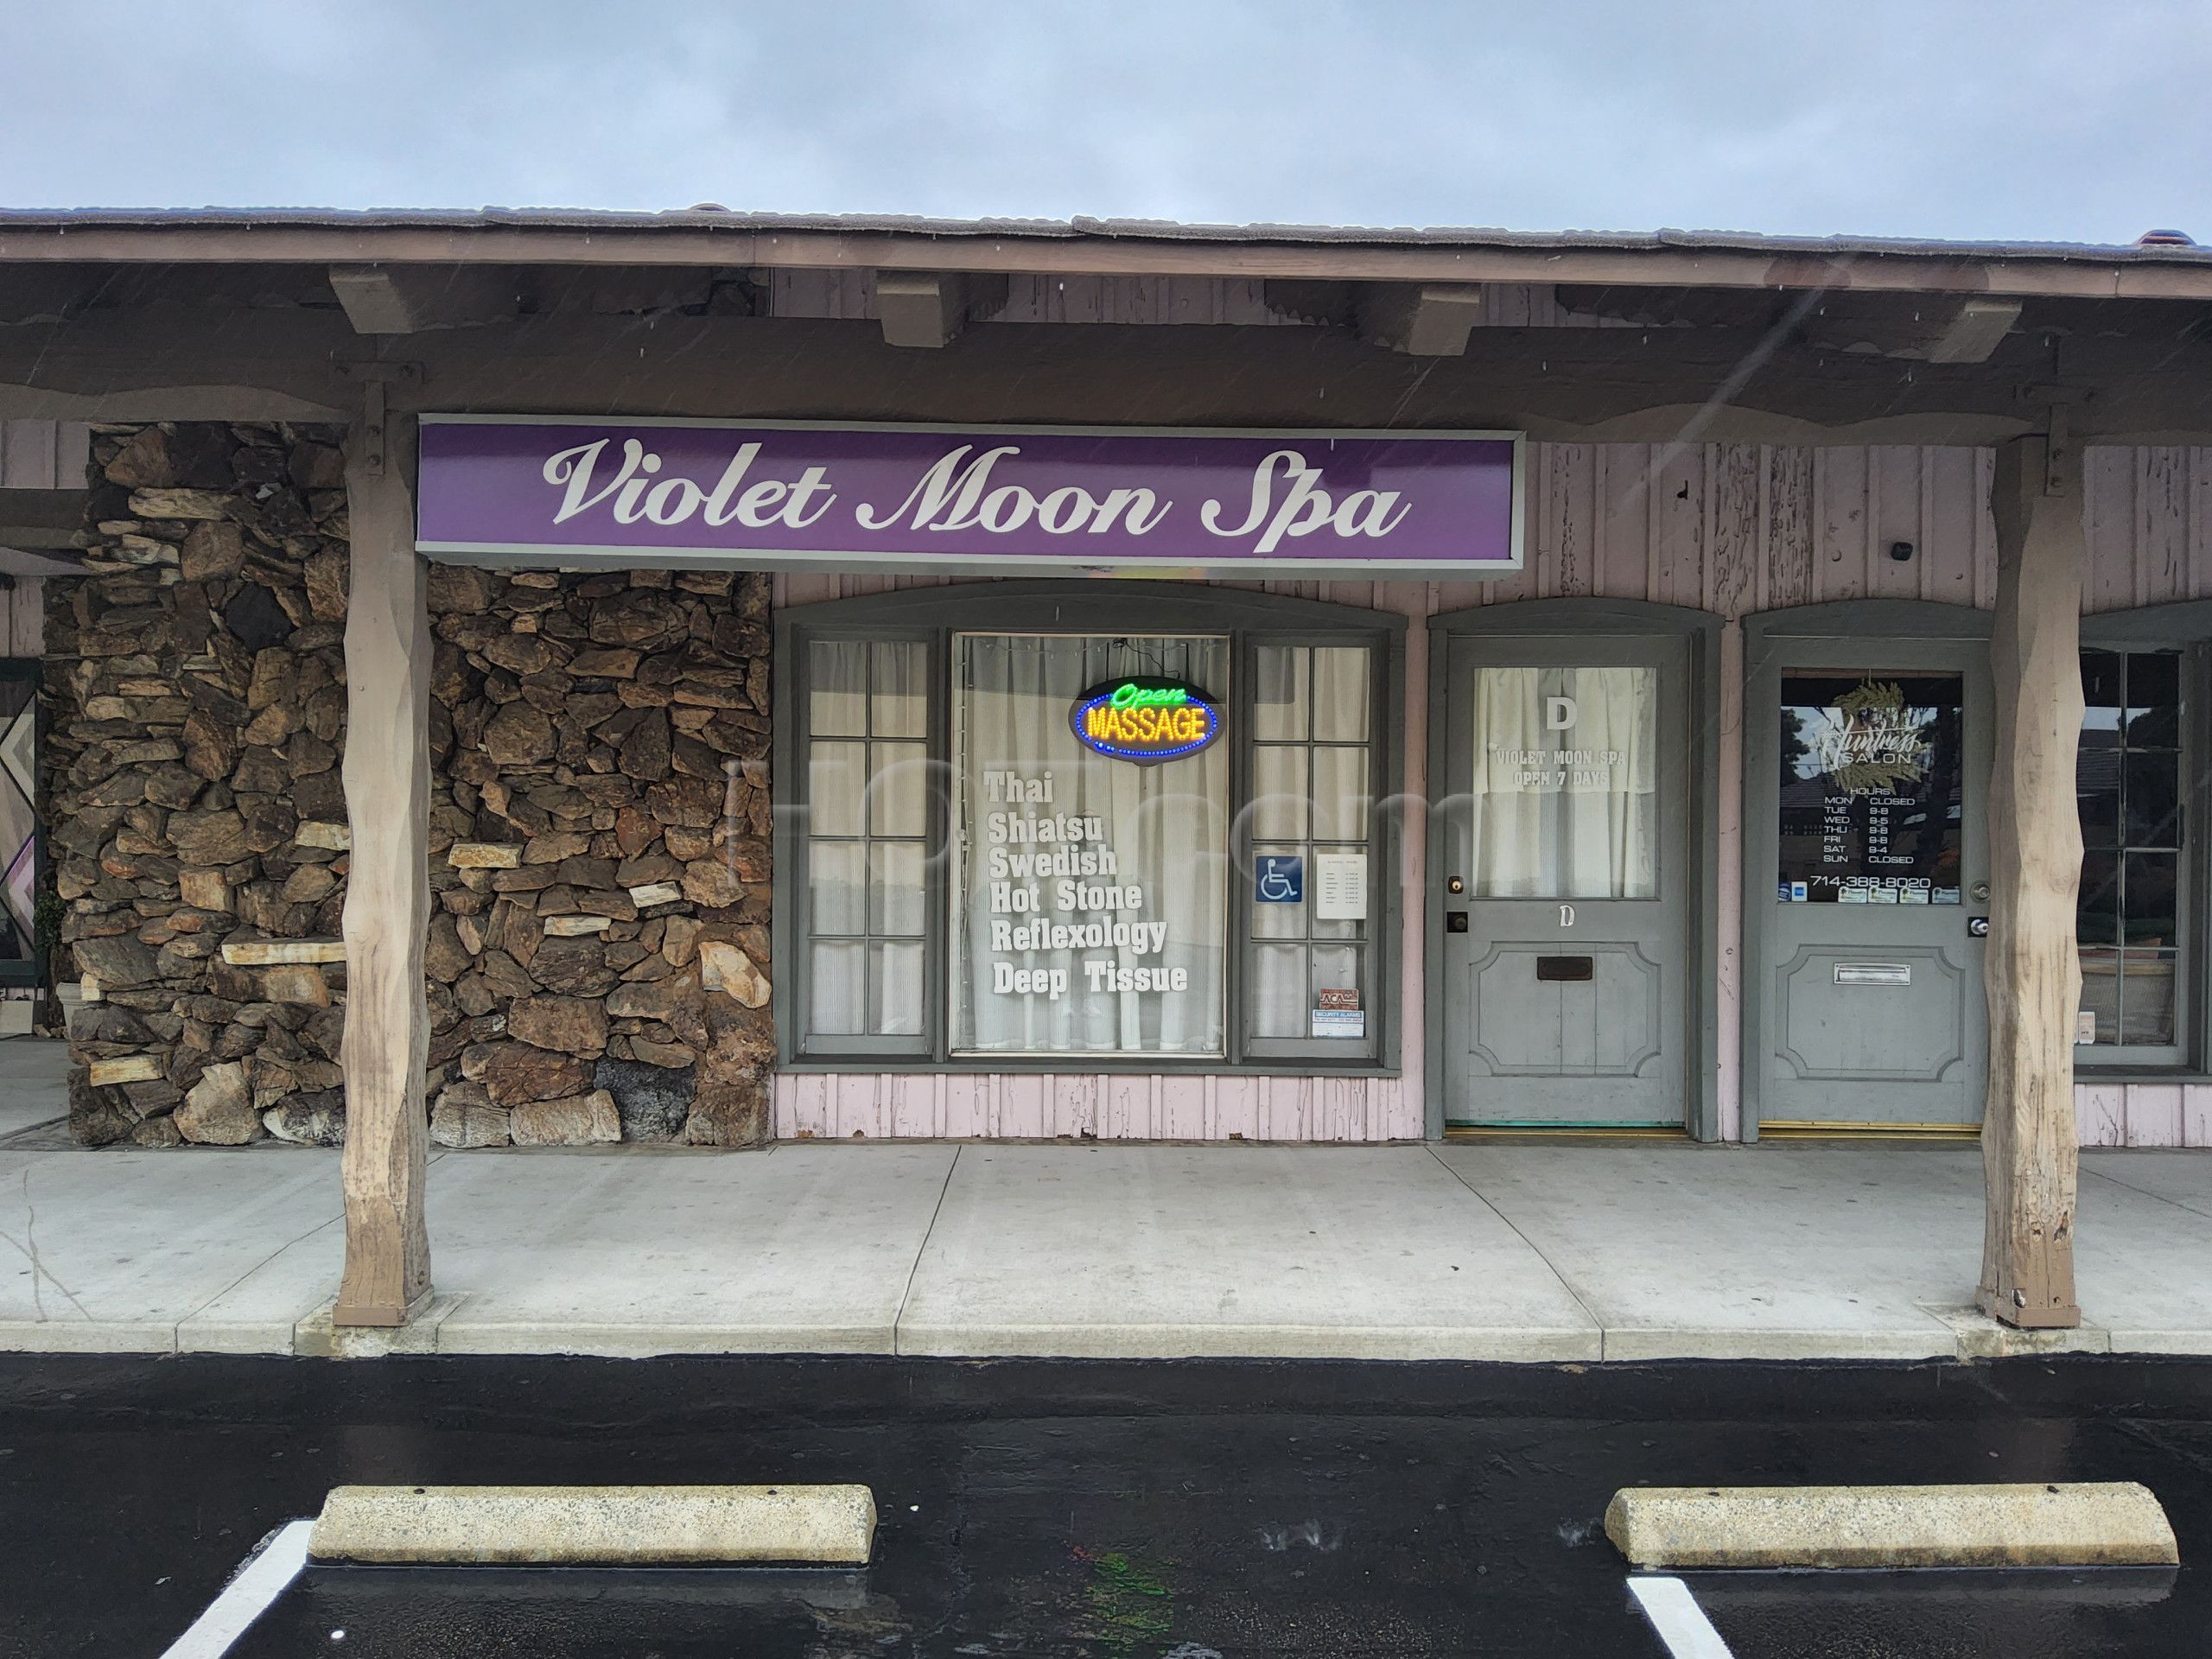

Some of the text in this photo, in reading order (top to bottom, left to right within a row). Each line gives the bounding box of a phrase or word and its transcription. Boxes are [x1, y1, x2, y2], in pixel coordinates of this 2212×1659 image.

[542, 437, 1413, 554] Violet Moon Spa
[1109, 683, 1187, 709] Open
[1087, 707, 1206, 742] MASSAGE
[1547, 696, 1578, 730] D
[1496, 749, 1628, 766] VIOLET MOON SPA
[1842, 753, 1912, 764] SALON
[983, 771, 1054, 803] Thai
[1513, 771, 1610, 786] OPEN 7 DAYS
[1824, 797, 1916, 806] MON CLOSED
[1850, 787, 1891, 796] HOURS
[987, 811, 1103, 844] Shiatsu
[1823, 825, 1889, 835] THU 9-8
[1824, 816, 1851, 824] WED
[988, 843, 1117, 879] Swedish
[1823, 855, 1914, 864] SUN CLOSED
[1810, 875, 1931, 888] 714-388-8020
[989, 880, 1142, 913] Hot Stone
[1560, 904, 1576, 927] D
[990, 915, 1168, 956] Reflexology
[993, 959, 1188, 1001] Deep Tissue
